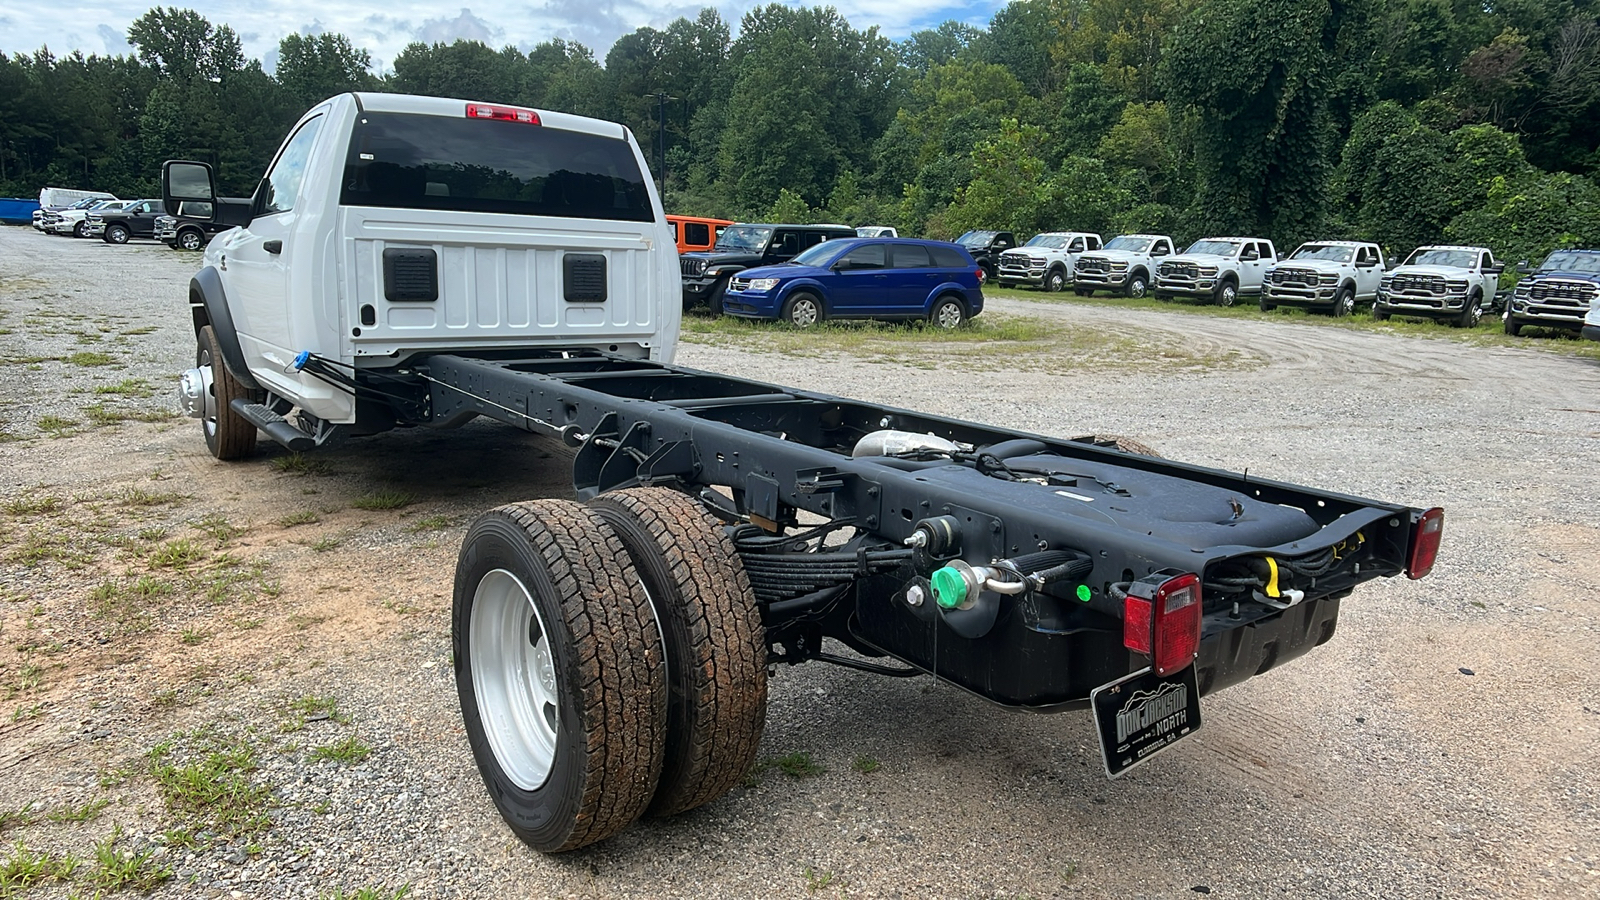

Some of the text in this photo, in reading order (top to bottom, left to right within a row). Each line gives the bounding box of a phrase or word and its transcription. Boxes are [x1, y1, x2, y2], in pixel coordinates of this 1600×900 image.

[1116, 687, 1188, 744] DON JACKSON
[1156, 709, 1187, 736] NORTH
